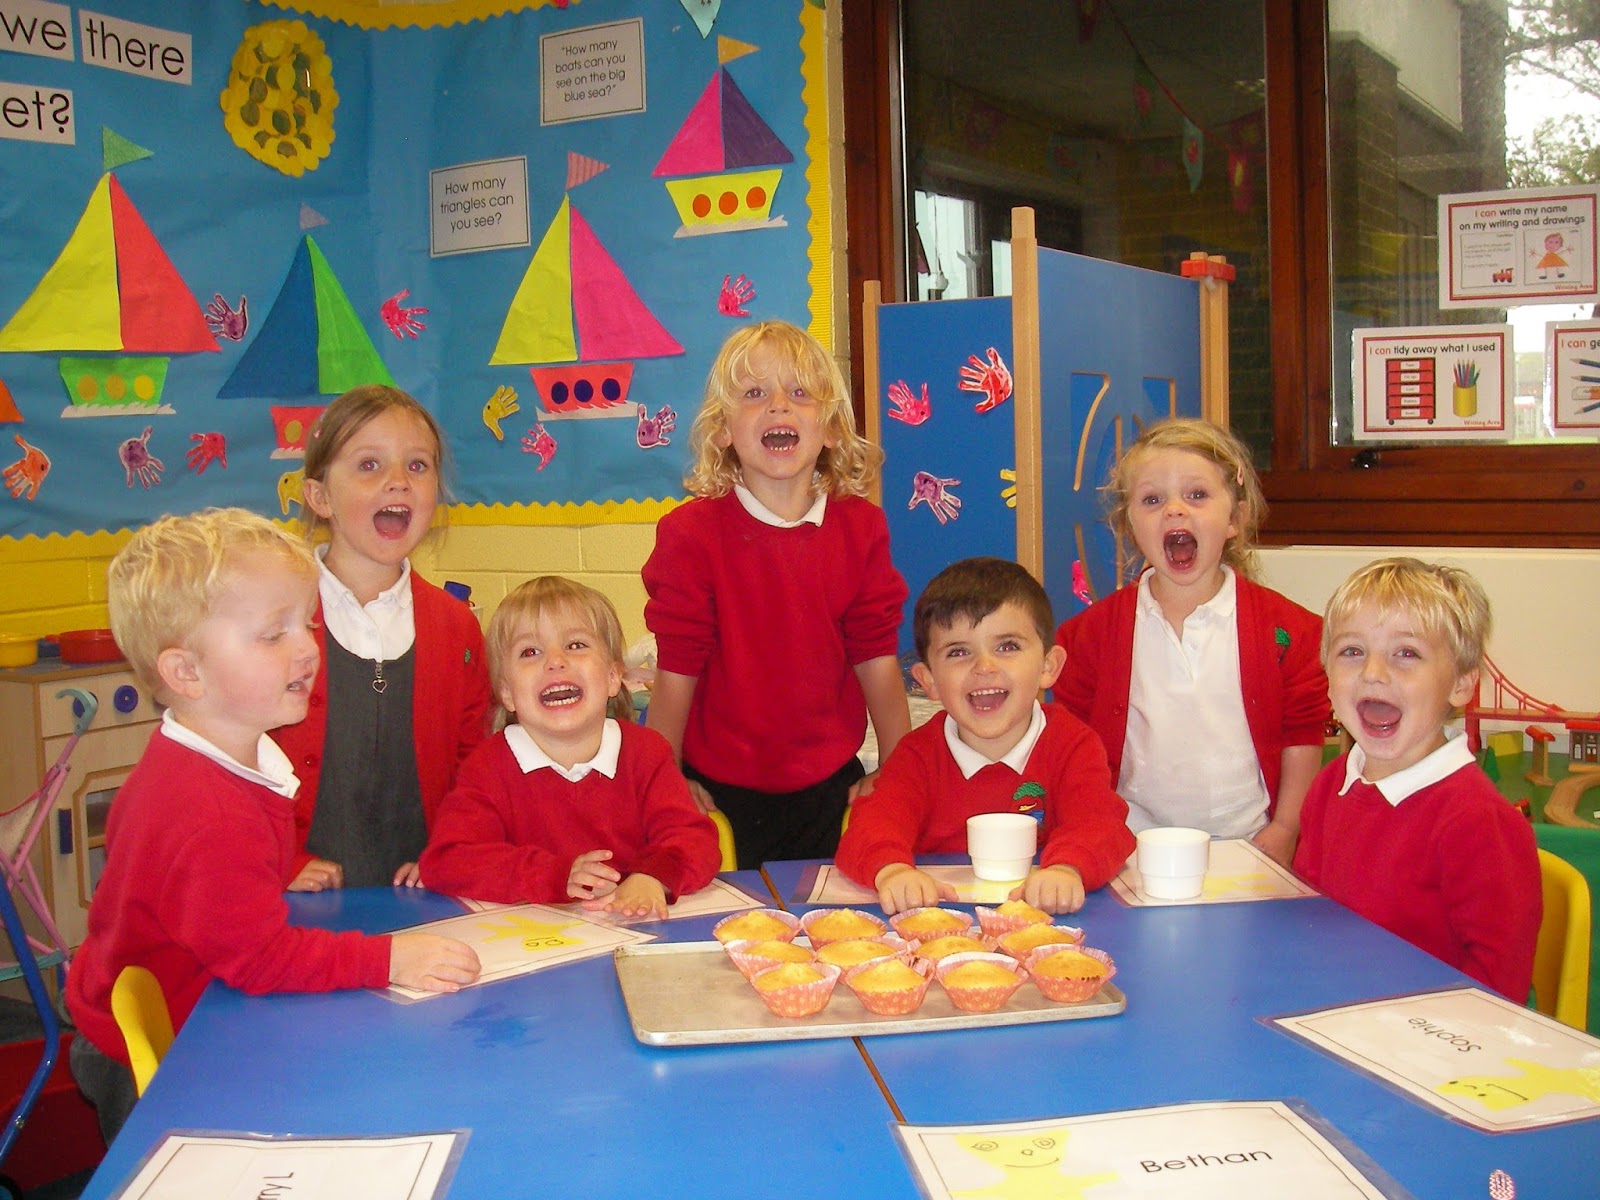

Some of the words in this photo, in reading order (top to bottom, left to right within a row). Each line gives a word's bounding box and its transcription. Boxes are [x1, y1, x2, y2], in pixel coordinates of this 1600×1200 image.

[0, 11, 67, 51] we
[86, 18, 185, 76] there
[589, 40, 618, 52] many
[555, 60, 582, 73] boats
[584, 58, 604, 68] can
[606, 54, 625, 67] you
[556, 79, 572, 89] see
[575, 76, 588, 85] on
[590, 72, 607, 82] the
[608, 69, 626, 81] big
[564, 91, 586, 102] blue
[2, 90, 70, 134] et?
[445, 183, 470, 195] How
[472, 177, 507, 191] many
[440, 198, 487, 214] triangles
[489, 195, 515, 207] can
[1480, 210, 1497, 218] can
[1499, 207, 1522, 217] write
[1524, 206, 1538, 215] my
[1540, 205, 1568, 214] name
[450, 218, 471, 233] you
[473, 212, 502, 228] see?
[1459, 223, 1471, 231] on
[1473, 221, 1487, 232] my
[1488, 217, 1519, 229] writing
[1521, 215, 1541, 226] and
[1542, 214, 1586, 226] drawings
[1393, 345, 1410, 356] tidy
[1412, 346, 1438, 354] away
[1440, 343, 1465, 353] what
[1472, 342, 1496, 353] used
[1567, 340, 1586, 348] can
[1408, 1017, 1481, 1052] Sophie
[1140, 1151, 1273, 1173] Bethan
